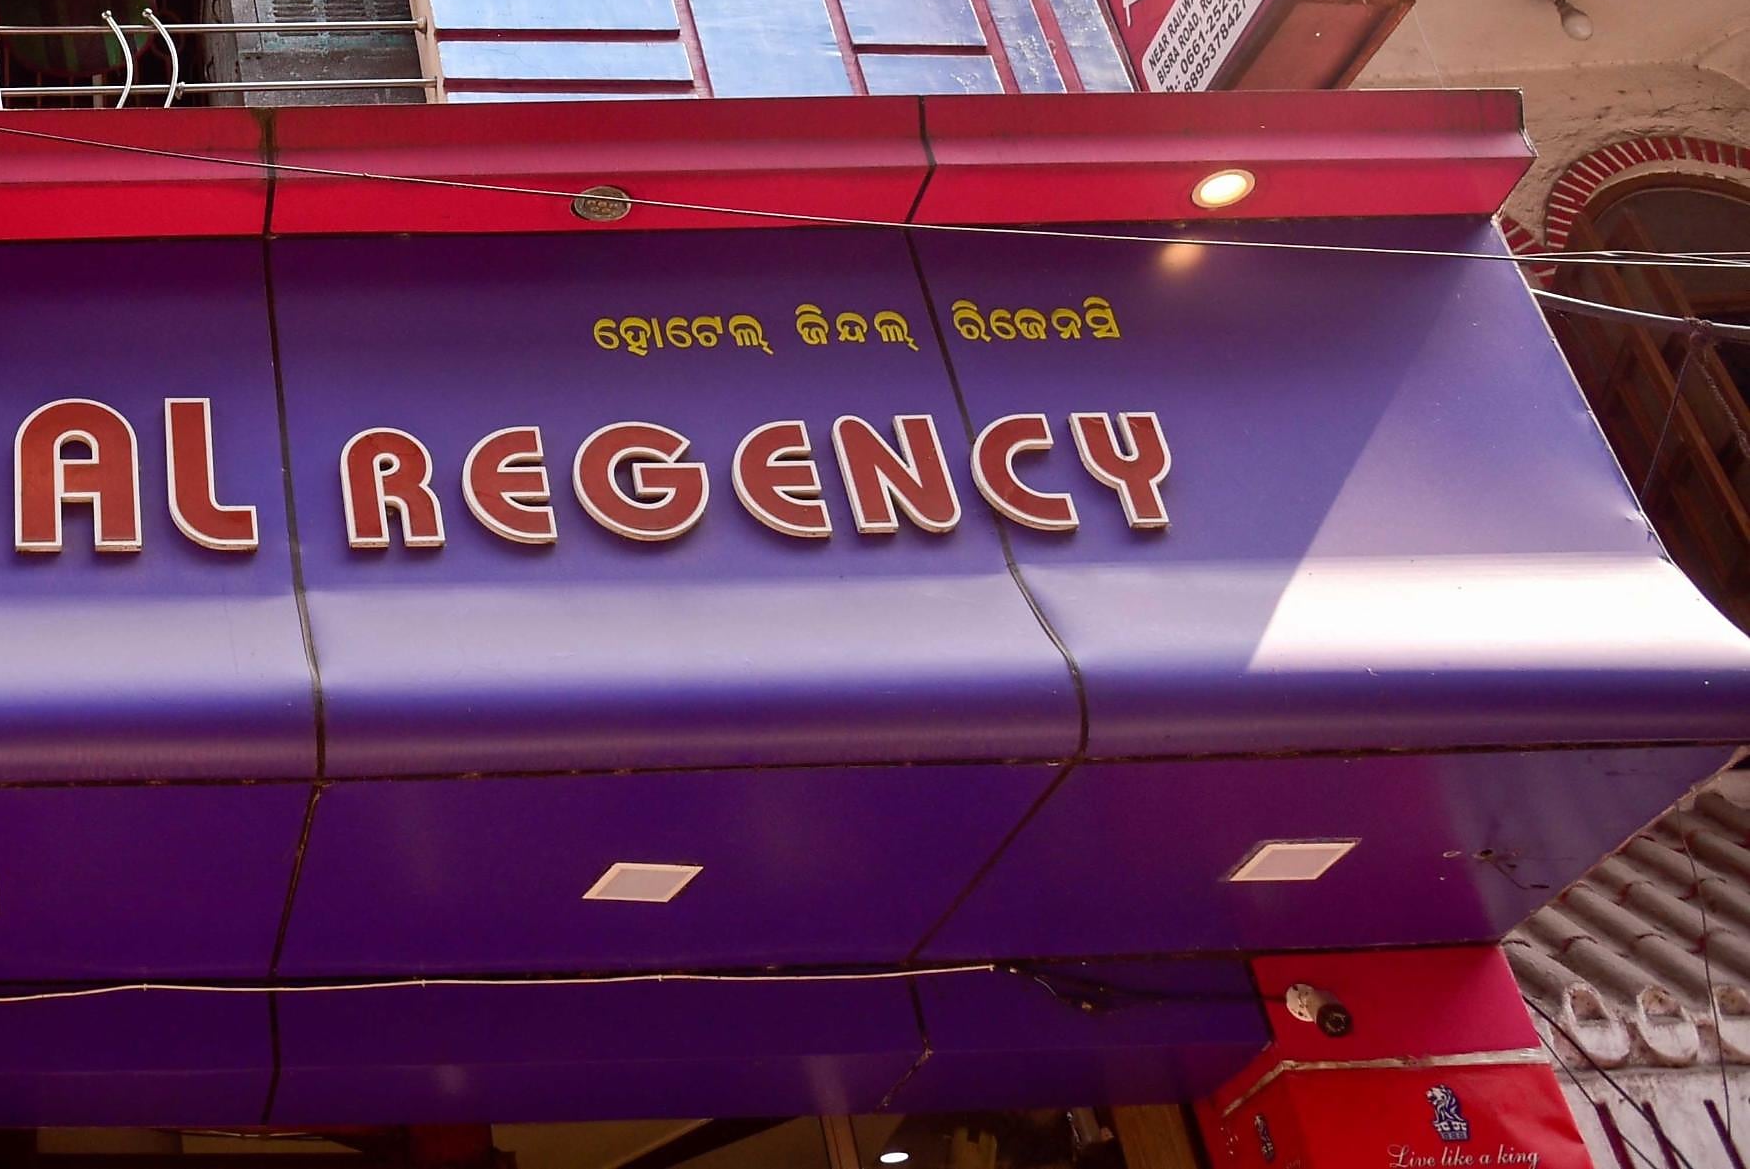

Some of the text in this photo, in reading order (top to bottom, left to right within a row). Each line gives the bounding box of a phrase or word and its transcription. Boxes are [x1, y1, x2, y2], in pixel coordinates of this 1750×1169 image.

[1149, 34, 1169, 71] NEAR
[1157, 47, 1180, 85] BISRA
[1179, 12, 1202, 50] ROAD,
[339, 411, 1171, 548] REGENCY
[1387, 1144, 1539, 1169] Live like a king
